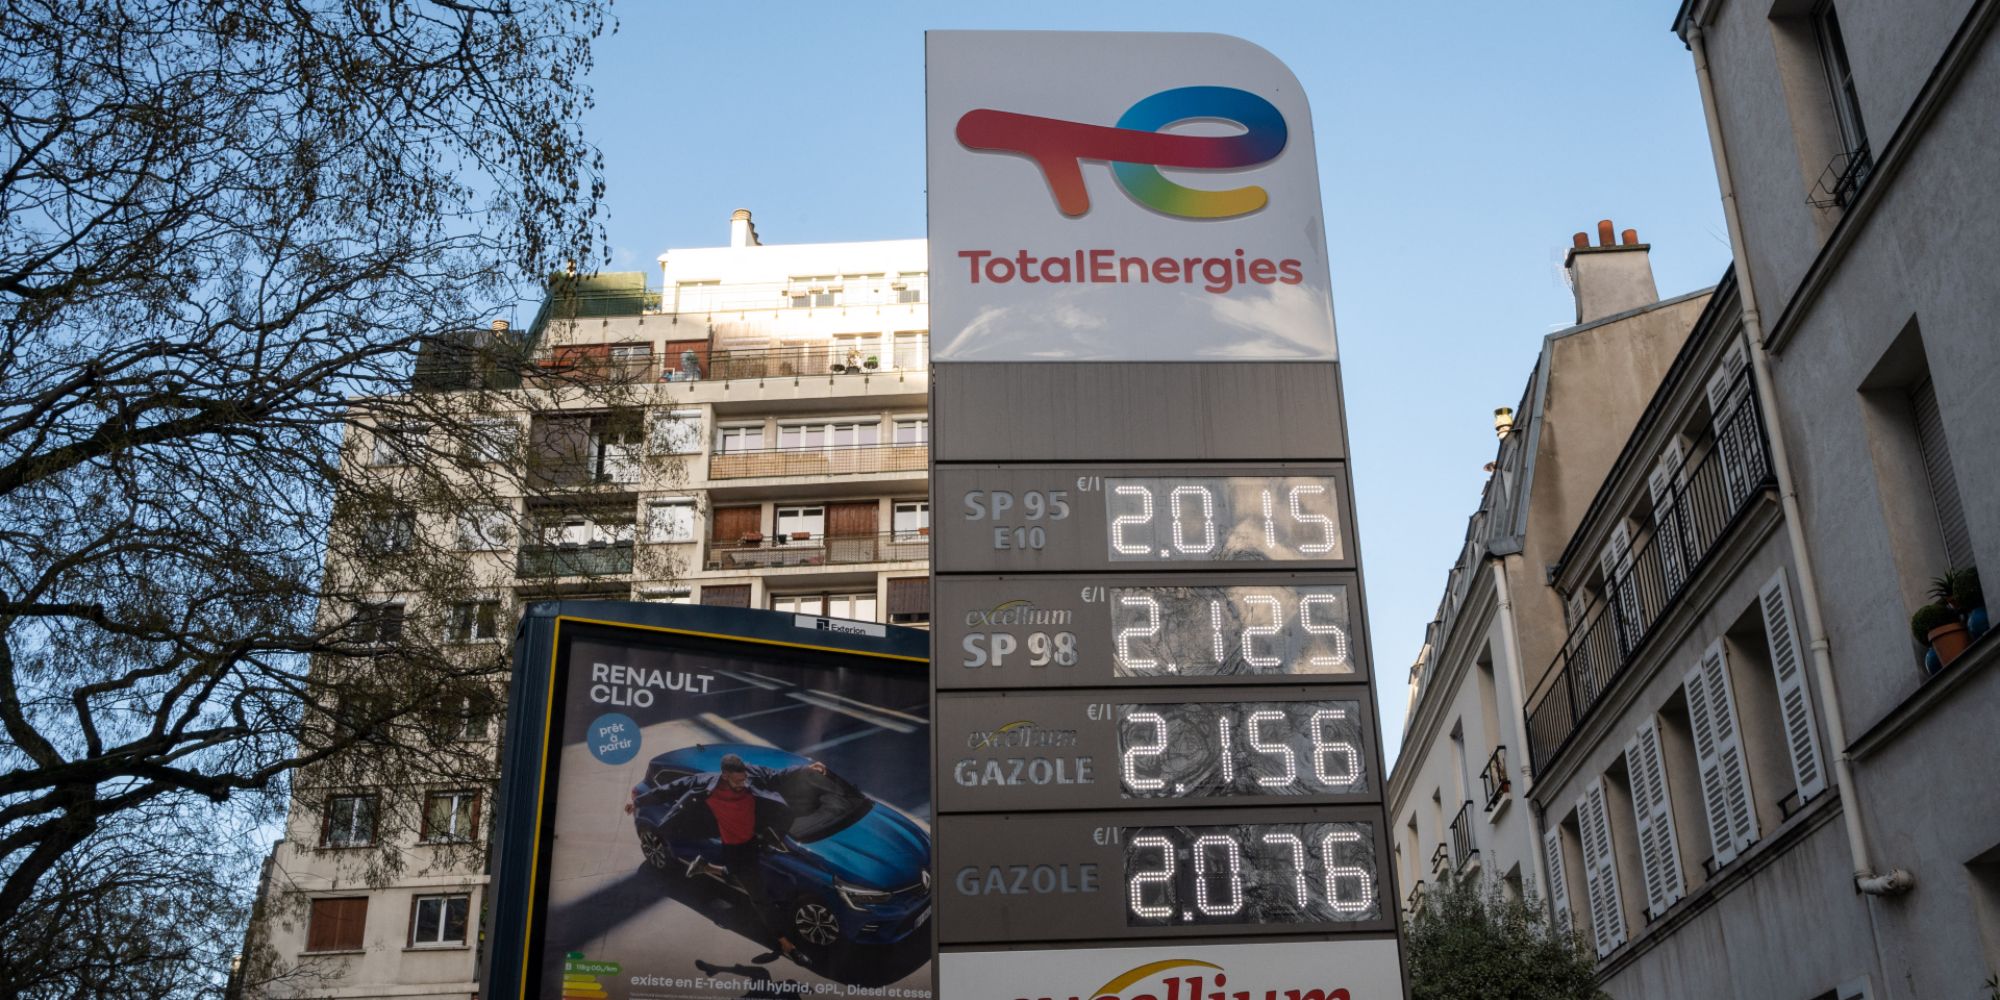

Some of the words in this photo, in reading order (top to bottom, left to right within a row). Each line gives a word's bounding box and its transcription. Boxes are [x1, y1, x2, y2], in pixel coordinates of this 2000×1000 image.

[958, 248, 1304, 294] TotalEnergies
[963, 490, 1015, 521] SP
[1023, 490, 1071, 521] 95
[1111, 484, 1336, 559] 2.015
[994, 525, 1046, 550] E10
[831, 623, 867, 636] Exterion
[965, 604, 1073, 626] excellium
[1116, 593, 1346, 673] 2.125
[962, 632, 1018, 668] SP
[1027, 631, 1080, 667] 98
[592, 662, 715, 694] RENAULT
[590, 684, 655, 708] CLIO
[599, 723, 625, 739] prêt
[967, 726, 1079, 749] excellium
[599, 738, 632, 756] partir
[1124, 709, 1359, 793] 2.156
[954, 756, 1096, 787] GAZOLE
[955, 863, 1100, 896] GAZOLE
[1129, 831, 1373, 922] 2.076
[630, 974, 674, 987] existe
[675, 976, 692, 989] en
[695, 977, 741, 991] E-Tech
[743, 979, 765, 992] full
[767, 980, 814, 995] hybrid,
[815, 983, 845, 997] GPL,
[847, 984, 886, 998] Diesel
[888, 986, 901, 998] et
[903, 988, 932, 999] esse
